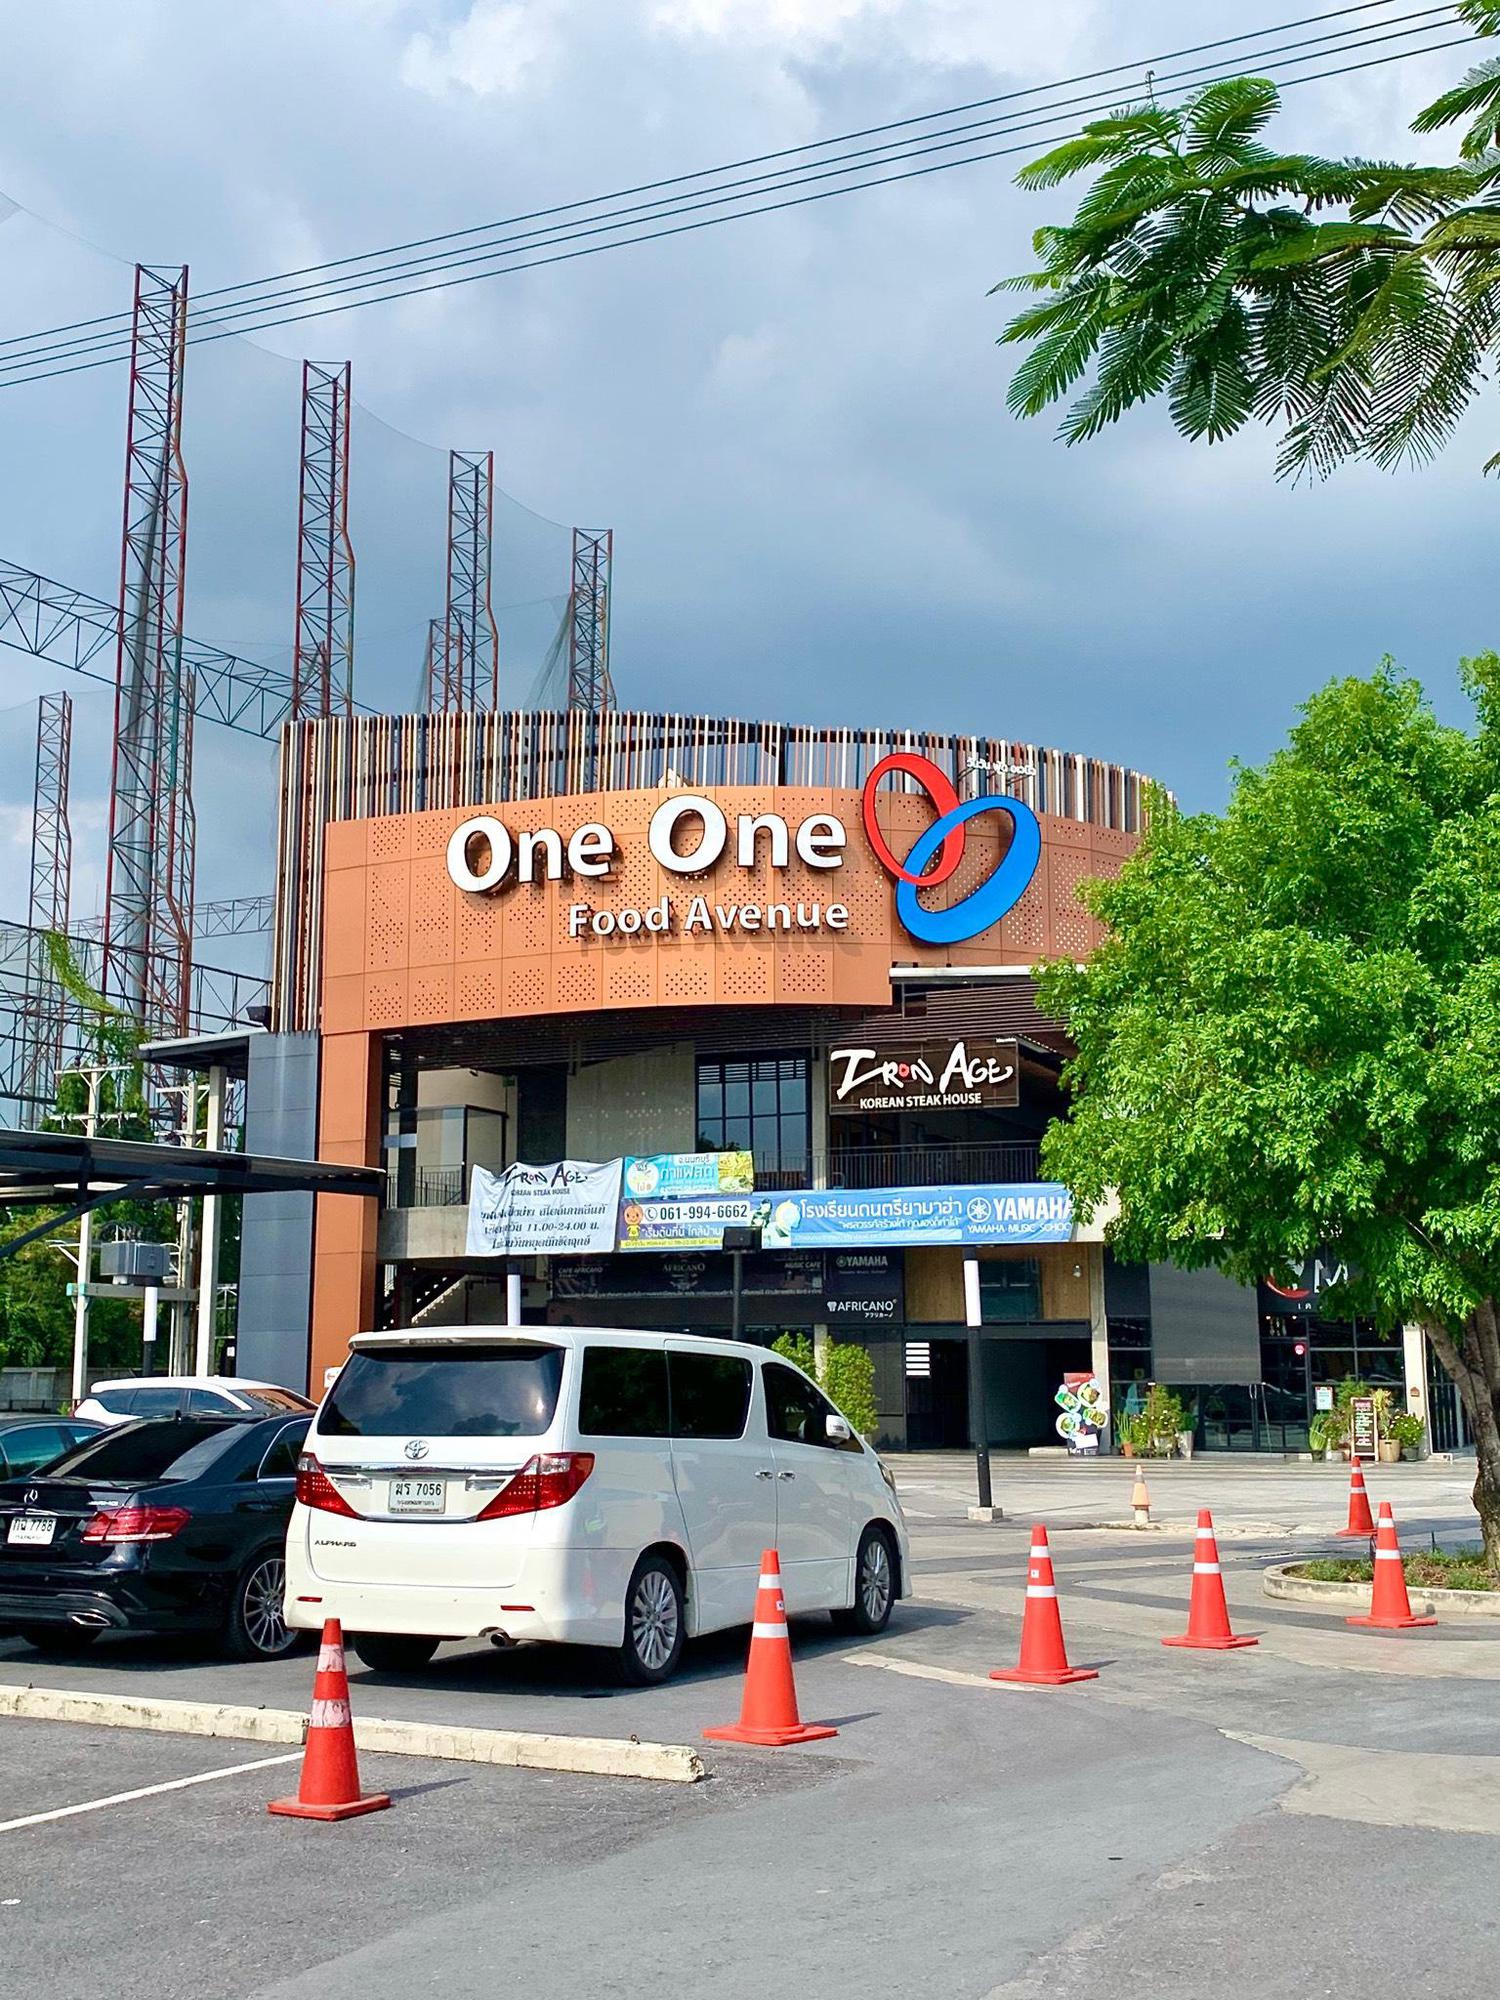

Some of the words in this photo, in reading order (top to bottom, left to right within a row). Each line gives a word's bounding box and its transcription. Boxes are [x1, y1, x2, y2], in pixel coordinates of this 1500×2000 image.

[446, 814, 614, 893] One
[647, 793, 847, 874] One
[568, 896, 670, 937] Food
[684, 897, 849, 931] Avenue
[939, 1041, 1014, 1094] AGE
[859, 1097, 905, 1110] KOREAN
[906, 1095, 942, 1107] STEAK
[943, 1092, 982, 1105] HOUSE
[660, 1204, 748, 1220] 061-994-6662
[800, 1196, 962, 1218] โรงเรียนดนตรียามาฮ่า
[527, 1221, 587, 1232] 11.00-24.00
[967, 1223, 1005, 1233] YAMAHA
[1007, 1223, 1035, 1233] MUSIC
[1040, 1222, 1072, 1232] SCHOO
[847, 1255, 888, 1267] YAMAHA
[837, 1300, 894, 1312] AFRICANO
[416, 1483, 442, 1496] 7056
